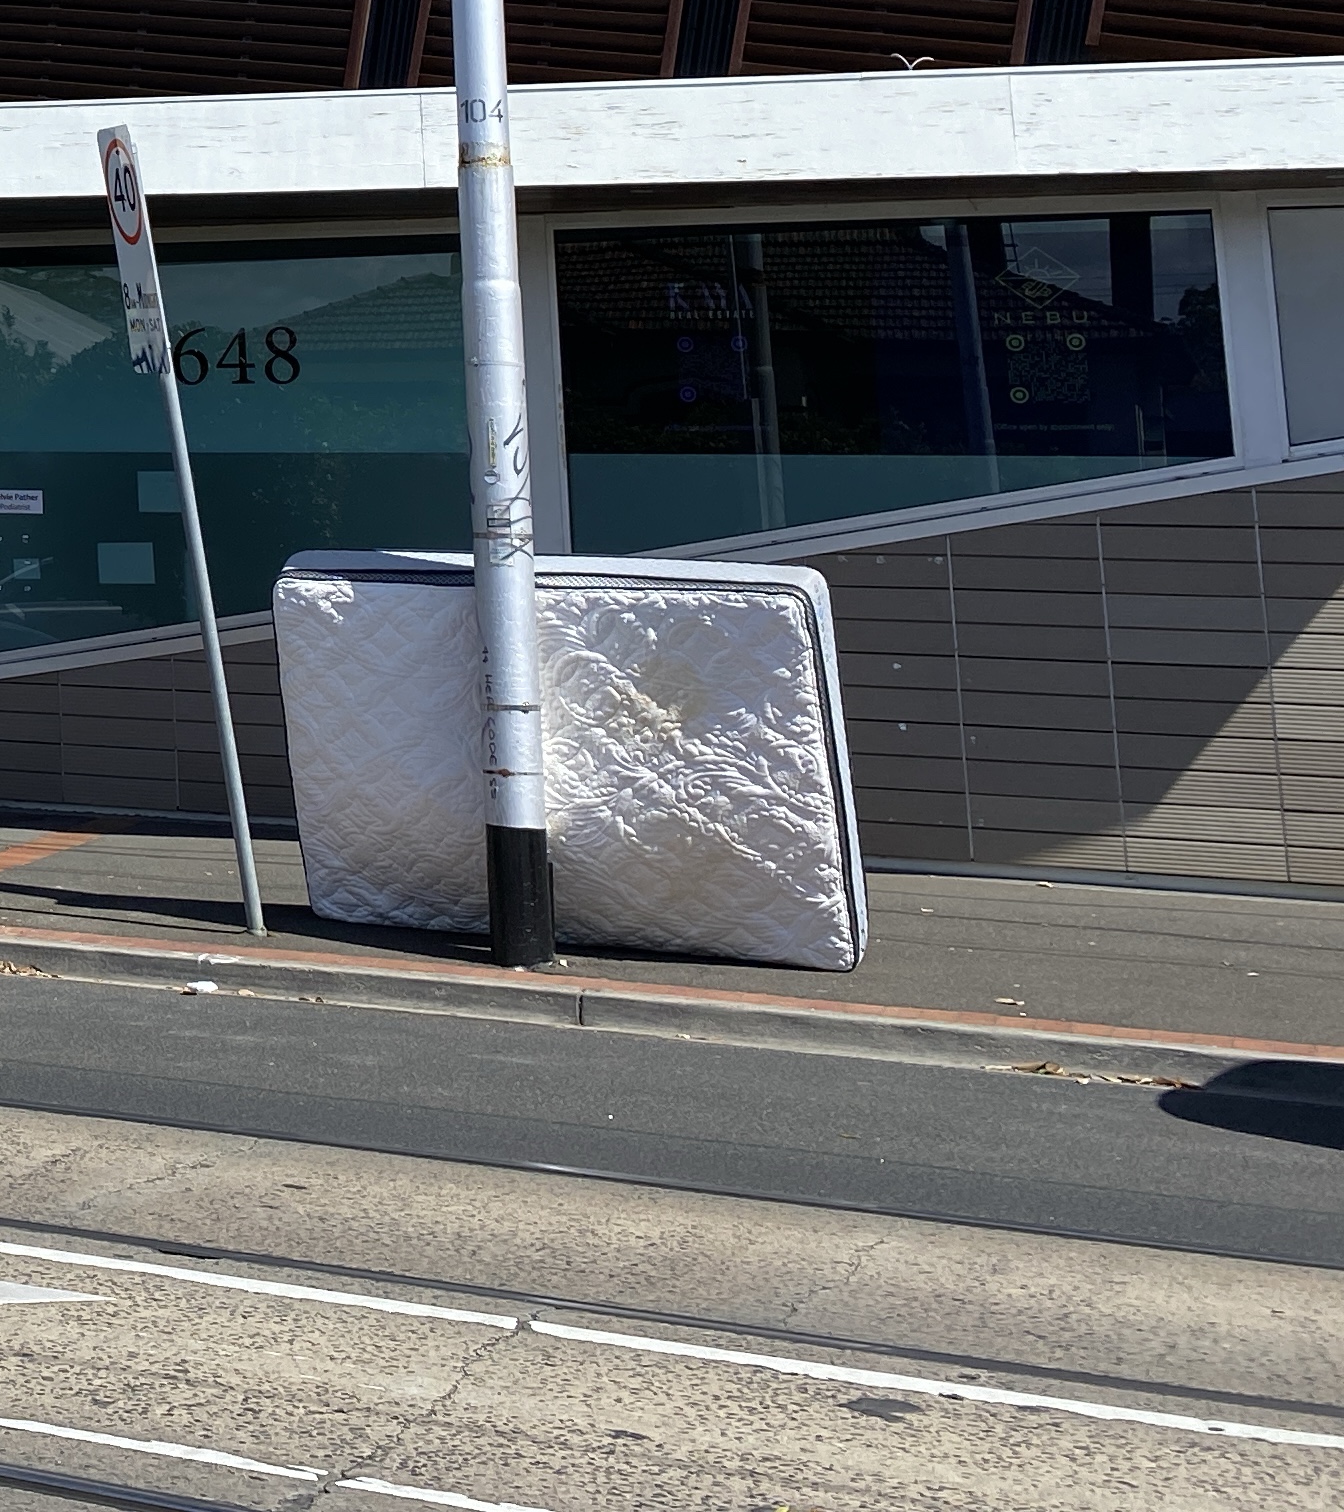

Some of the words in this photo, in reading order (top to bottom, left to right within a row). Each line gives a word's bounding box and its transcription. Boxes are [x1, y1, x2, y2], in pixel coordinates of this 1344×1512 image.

[460, 98, 504, 124] 104
[114, 165, 136, 212] 40
[994, 310, 1089, 326] NEBU
[173, 326, 301, 386] 648
